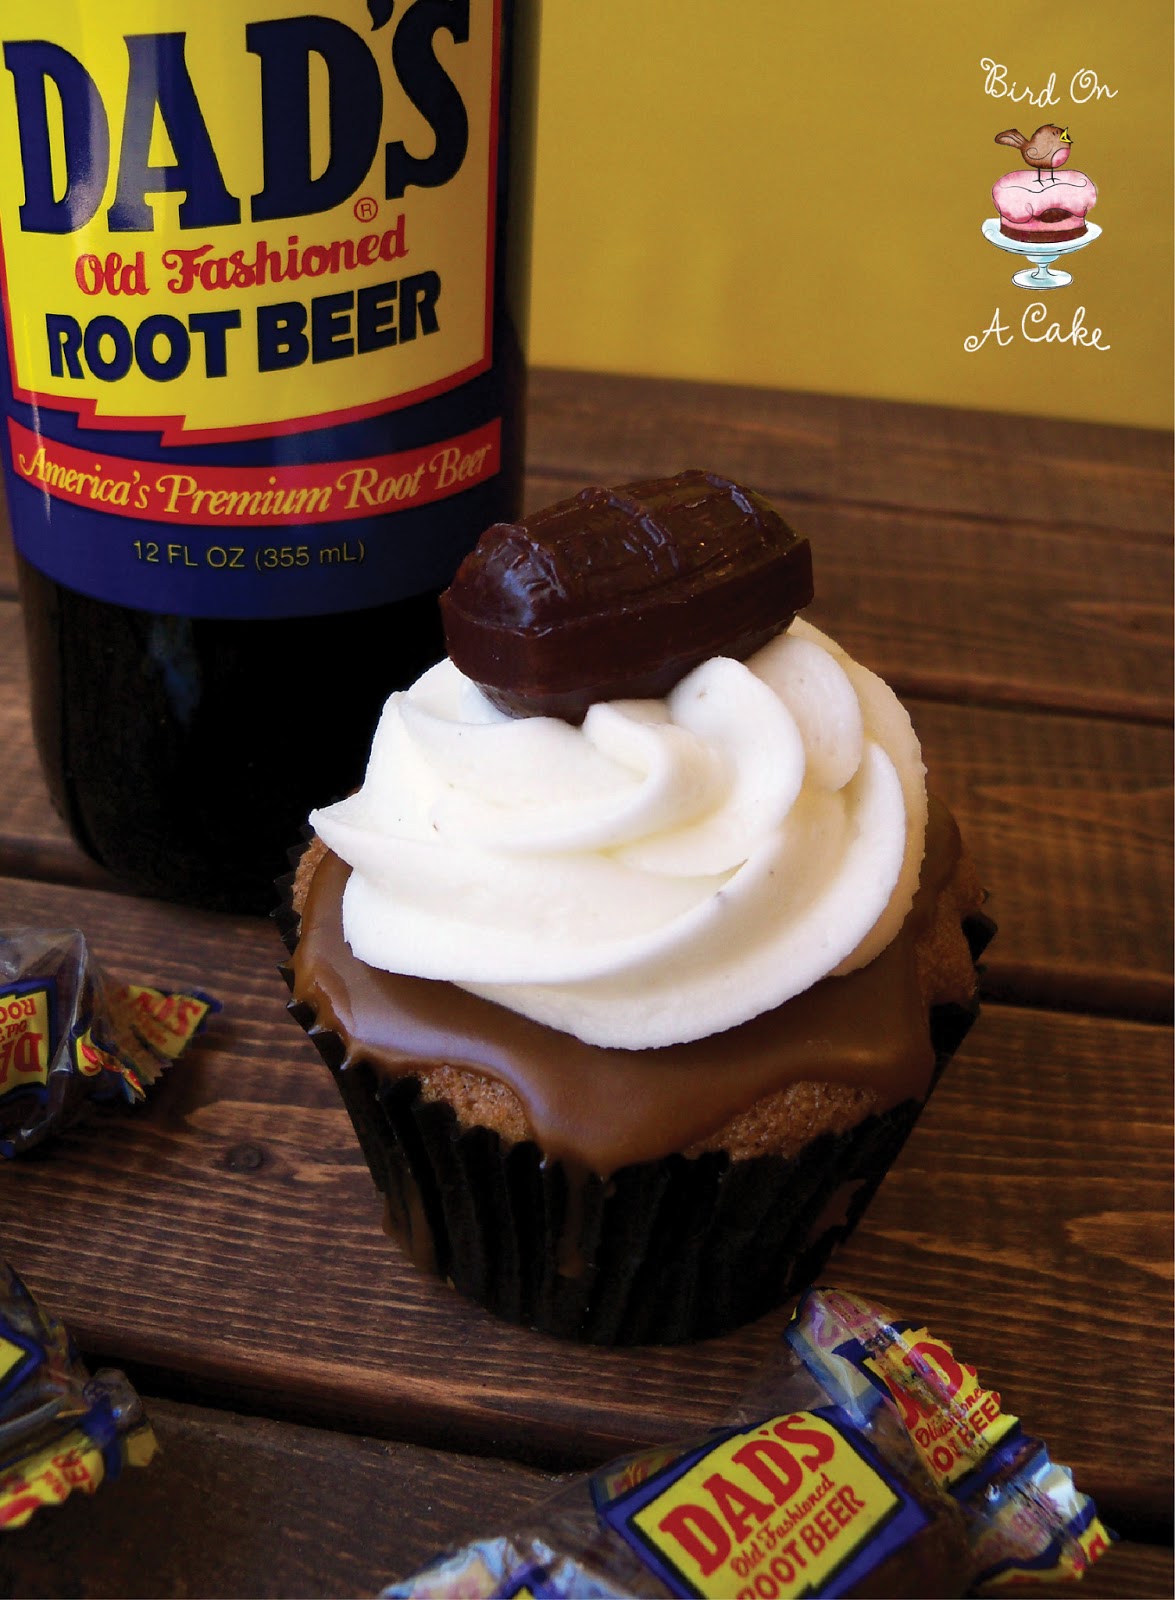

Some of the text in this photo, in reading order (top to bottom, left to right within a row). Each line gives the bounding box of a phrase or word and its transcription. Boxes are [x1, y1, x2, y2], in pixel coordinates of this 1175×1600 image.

[3, 0, 470, 235] DAD'S
[75, 213, 411, 296] Old Fashioned
[45, 270, 442, 382] ROOT BEER
[19, 443, 493, 517] America's Premium Root Beer
[133, 539, 366, 571] 12 FL OZ (355 mL)
[0, 998, 37, 1024] ROO
[658, 1415, 835, 1577] DAD'S
[730, 1472, 836, 1578] Old Fashioned
[799, 1484, 866, 1557] BEER
